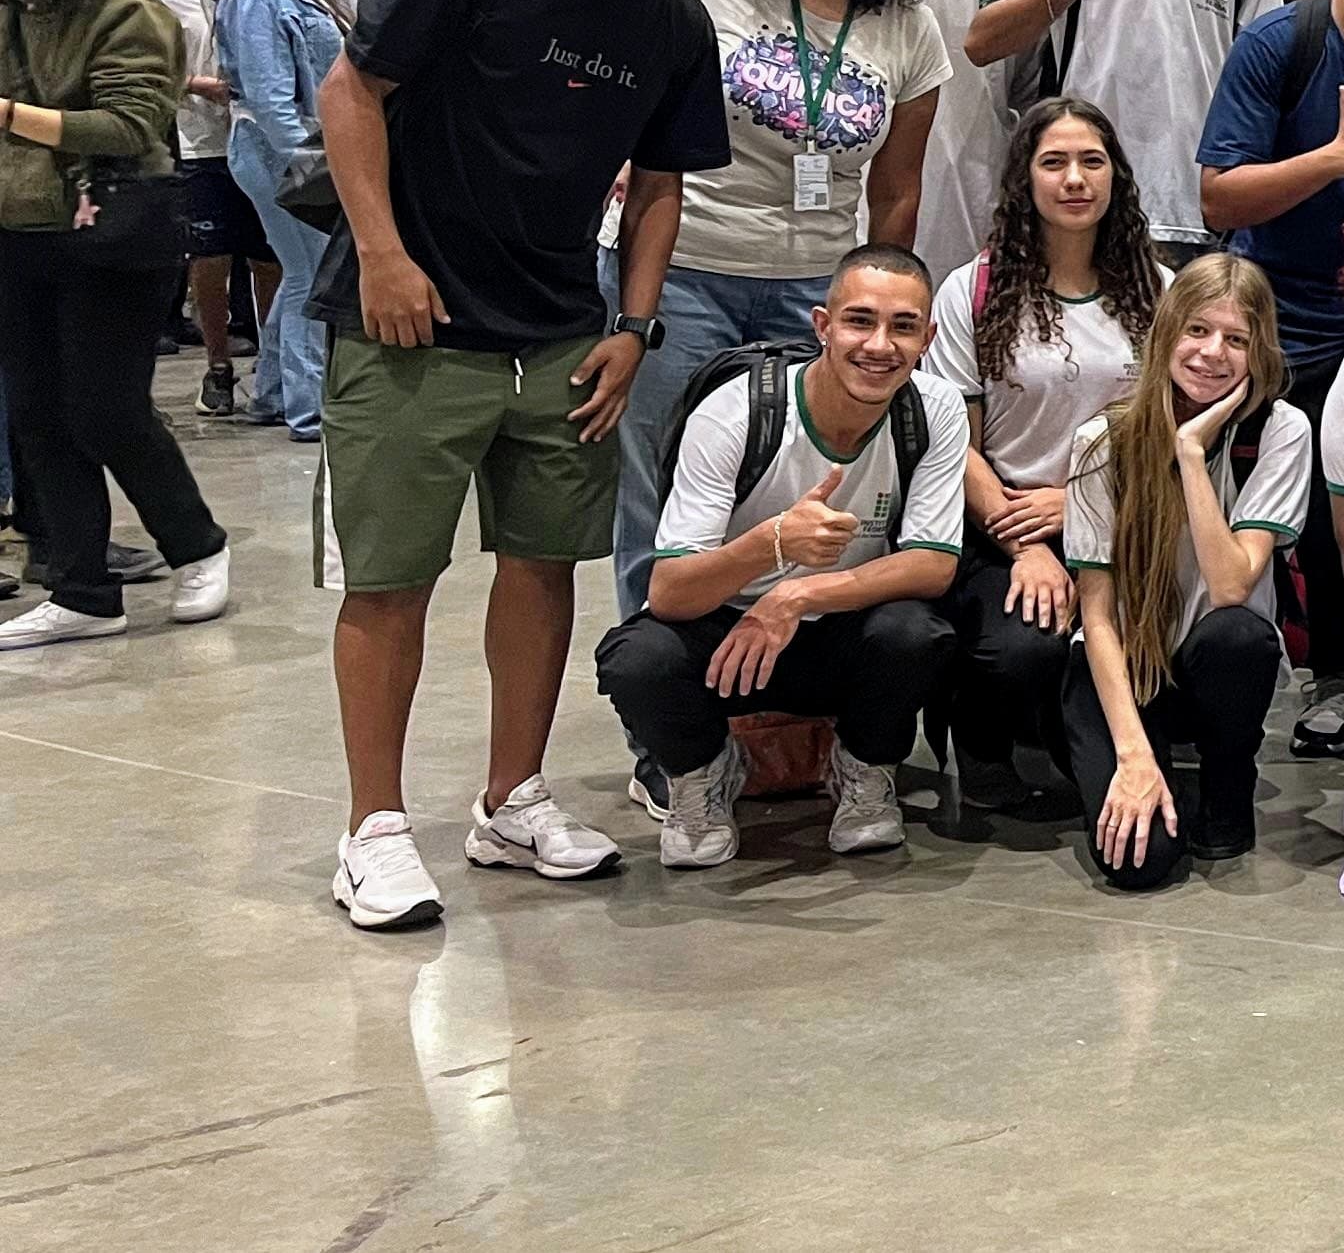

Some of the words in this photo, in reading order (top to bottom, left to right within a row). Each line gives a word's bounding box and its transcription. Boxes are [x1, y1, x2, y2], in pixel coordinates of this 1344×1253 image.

[540, 38, 582, 68] Just
[585, 53, 613, 78] do
[618, 64, 637, 89] it.
